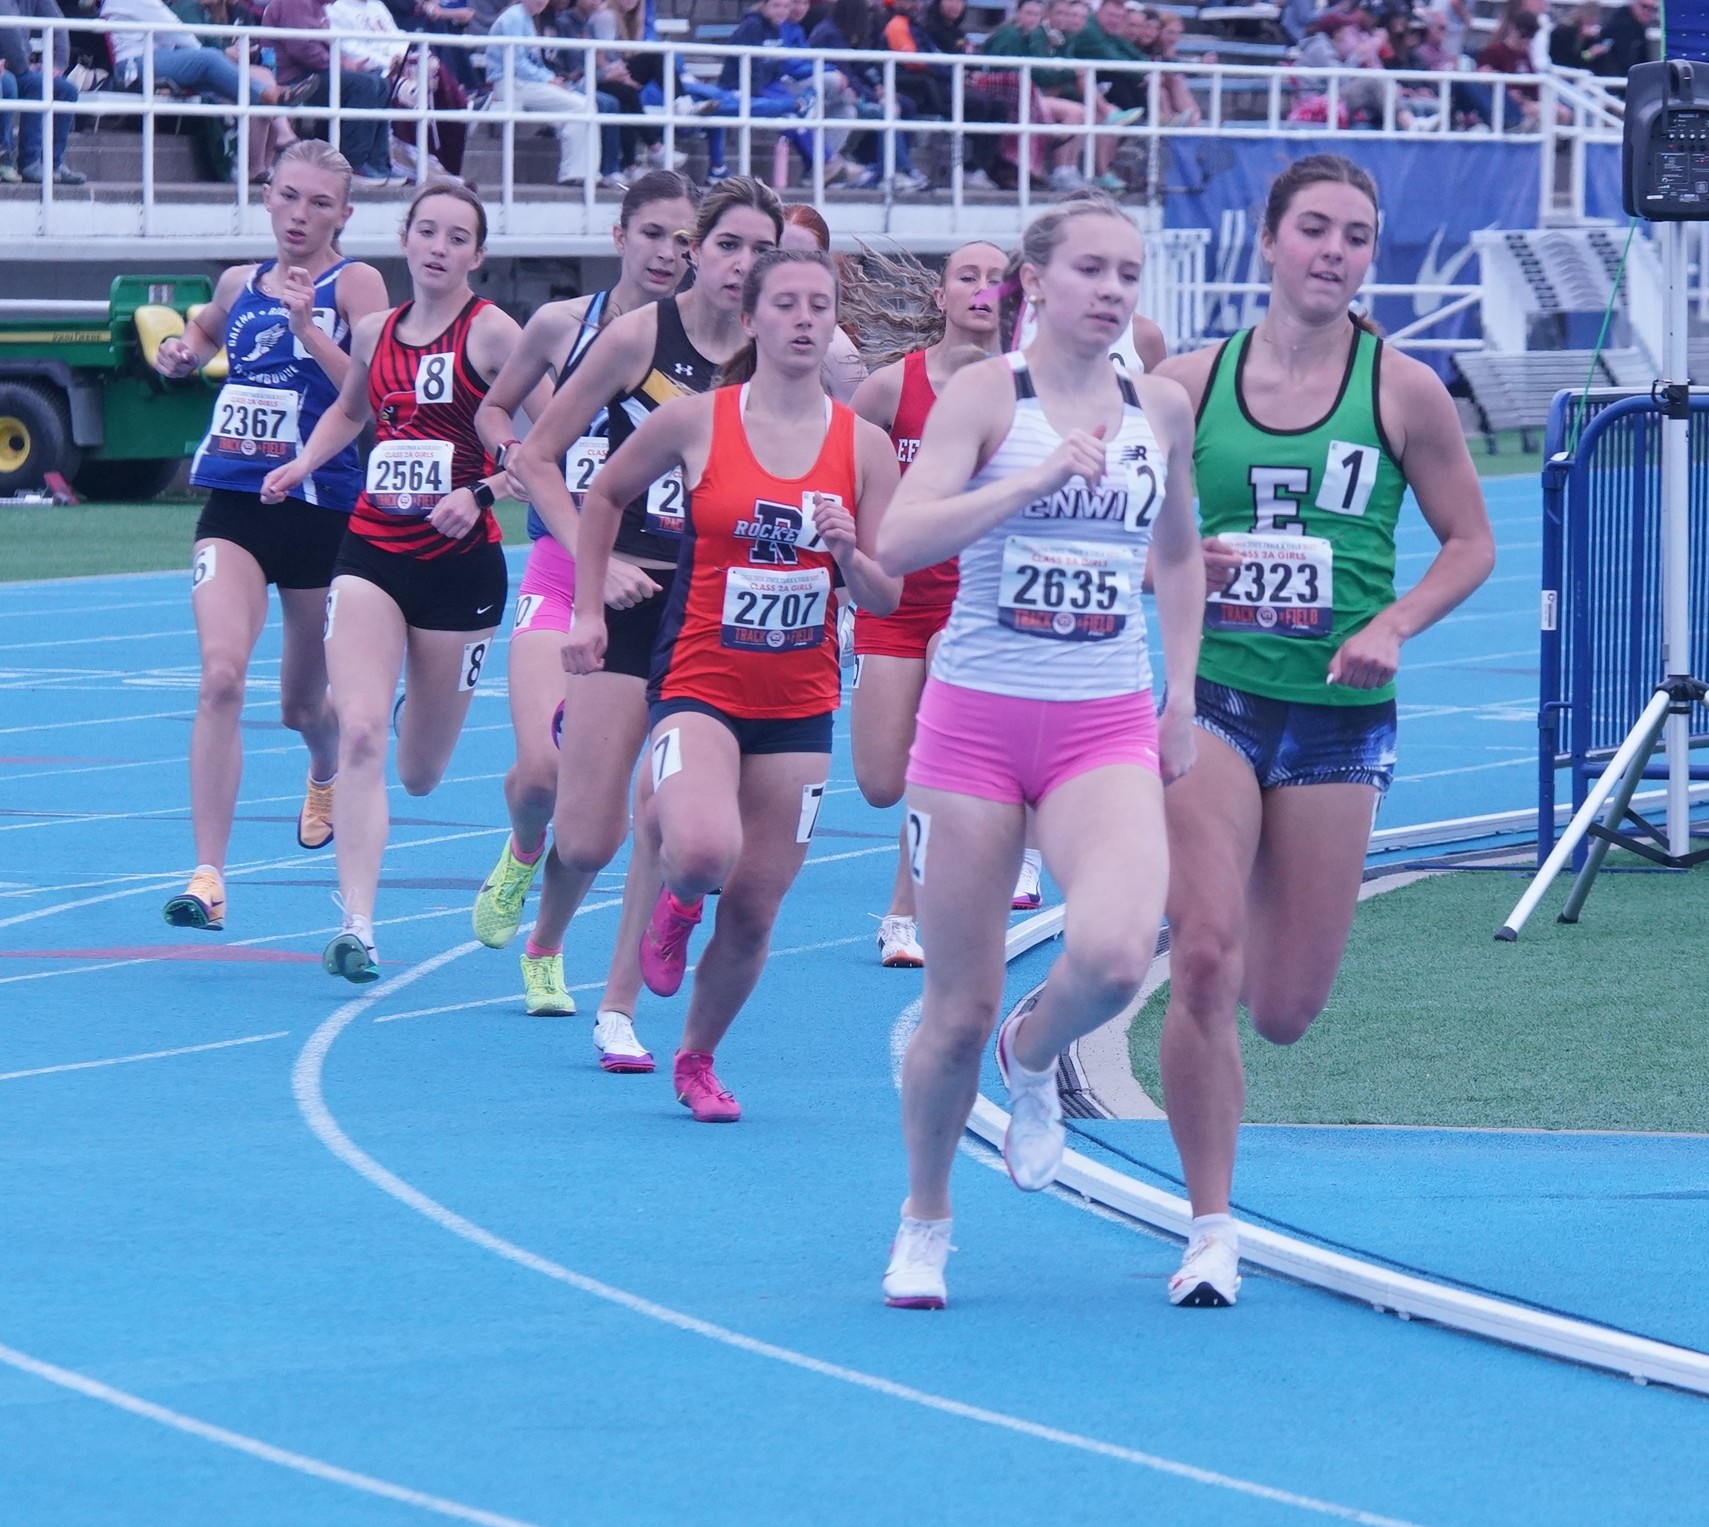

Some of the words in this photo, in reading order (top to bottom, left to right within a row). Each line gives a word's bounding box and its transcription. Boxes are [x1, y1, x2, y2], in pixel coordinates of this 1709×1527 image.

[228, 311, 256, 347] GALENA
[423, 358, 446, 401] 8
[220, 404, 287, 438] 2367
[374, 460, 443, 491] 2564
[1136, 464, 1157, 527] 2
[1341, 449, 1364, 510] 1
[1248, 465, 1312, 537] E
[1262, 551, 1275, 559] 2A
[1278, 552, 1307, 560] GIRLS
[750, 582, 776, 592] CLASS
[791, 582, 813, 592] GIRLS
[1012, 564, 1119, 610] 2635
[1219, 562, 1319, 604] 2323
[734, 591, 820, 628] 2707
[1221, 604, 1255, 622] TRACK
[1286, 607, 1318, 625] FIELD
[735, 627, 767, 642] TRACK
[791, 628, 814, 643] FIELD
[466, 643, 486, 687] 8
[654, 734, 670, 780] 7
[806, 786, 824, 839] 7
[910, 813, 921, 878] 2
